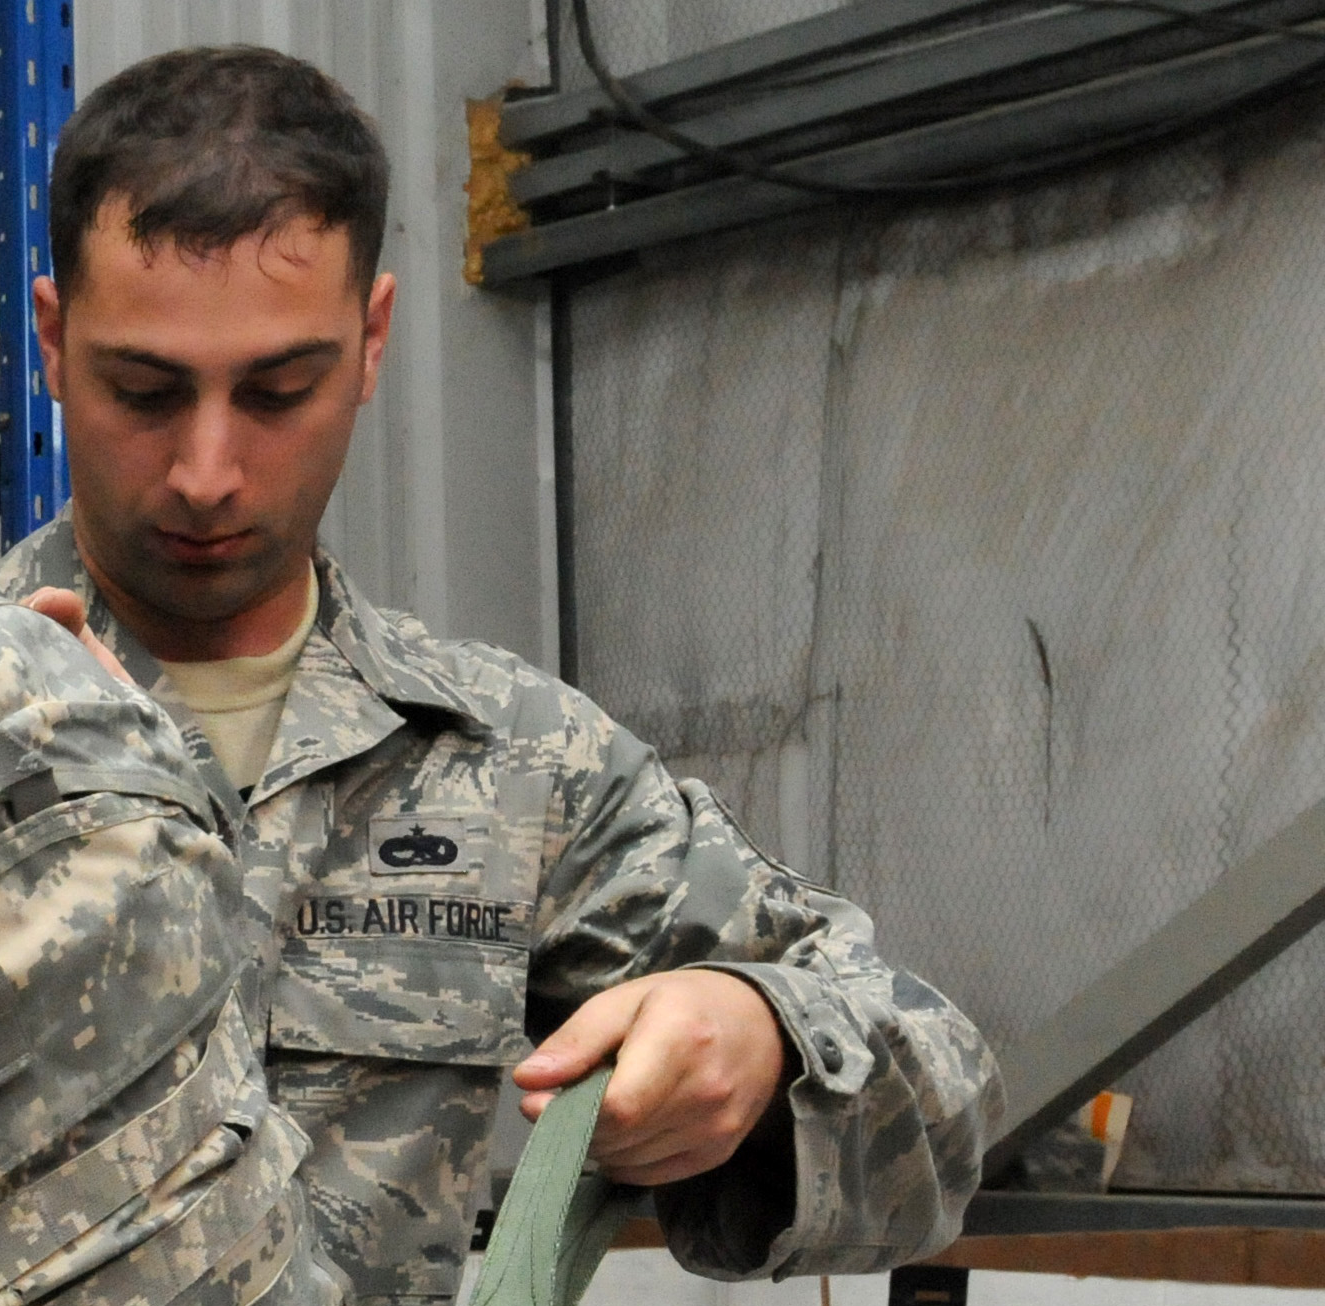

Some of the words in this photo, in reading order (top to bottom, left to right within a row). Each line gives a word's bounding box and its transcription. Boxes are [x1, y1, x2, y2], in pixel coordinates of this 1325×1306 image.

[297, 898, 353, 935] U.S.
[363, 898, 420, 935] AIR
[428, 899, 512, 942] FORCE
